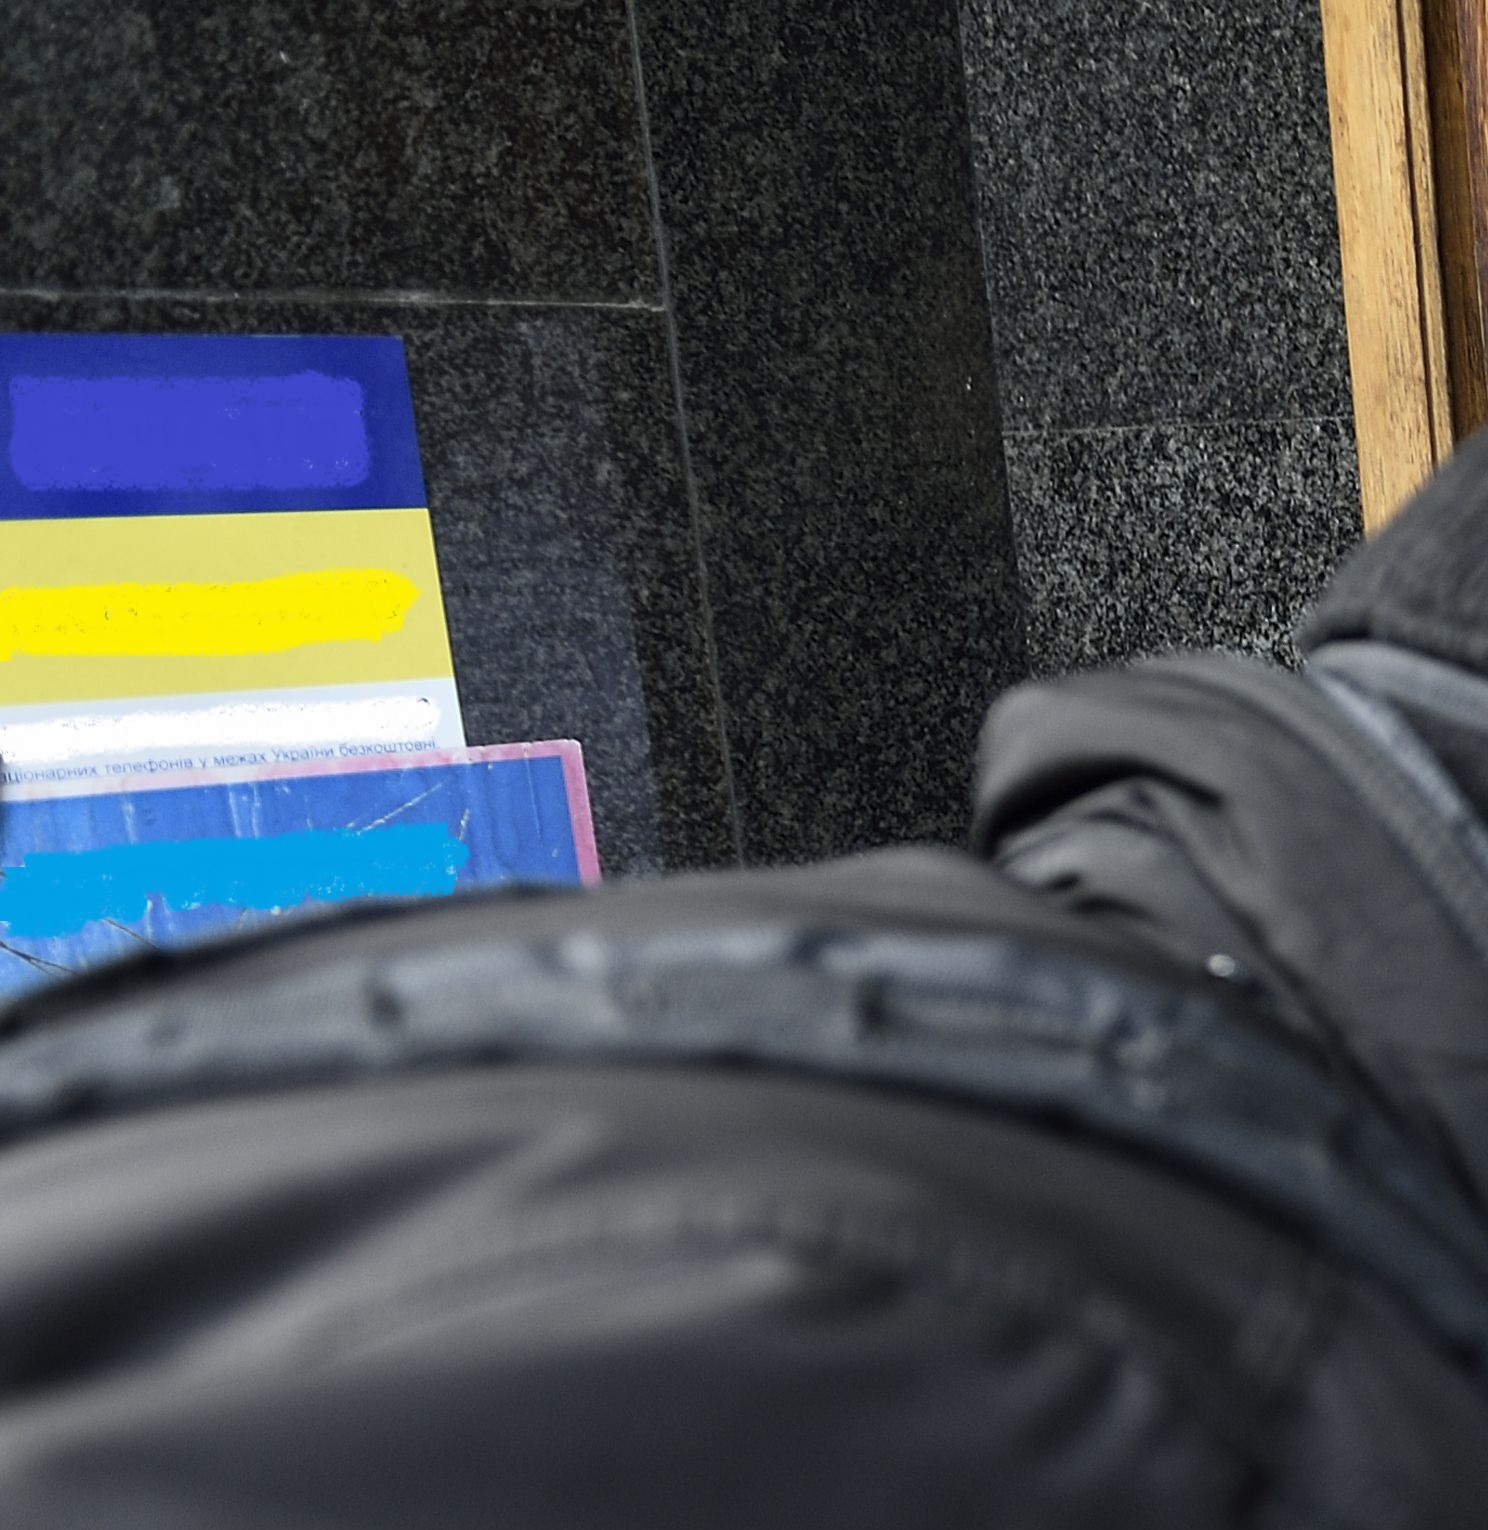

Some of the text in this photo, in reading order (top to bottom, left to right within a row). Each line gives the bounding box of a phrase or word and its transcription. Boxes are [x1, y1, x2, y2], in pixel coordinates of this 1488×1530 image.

[105, 756, 194, 776] телефонів
[214, 752, 267, 767] межах
[272, 747, 334, 763] України
